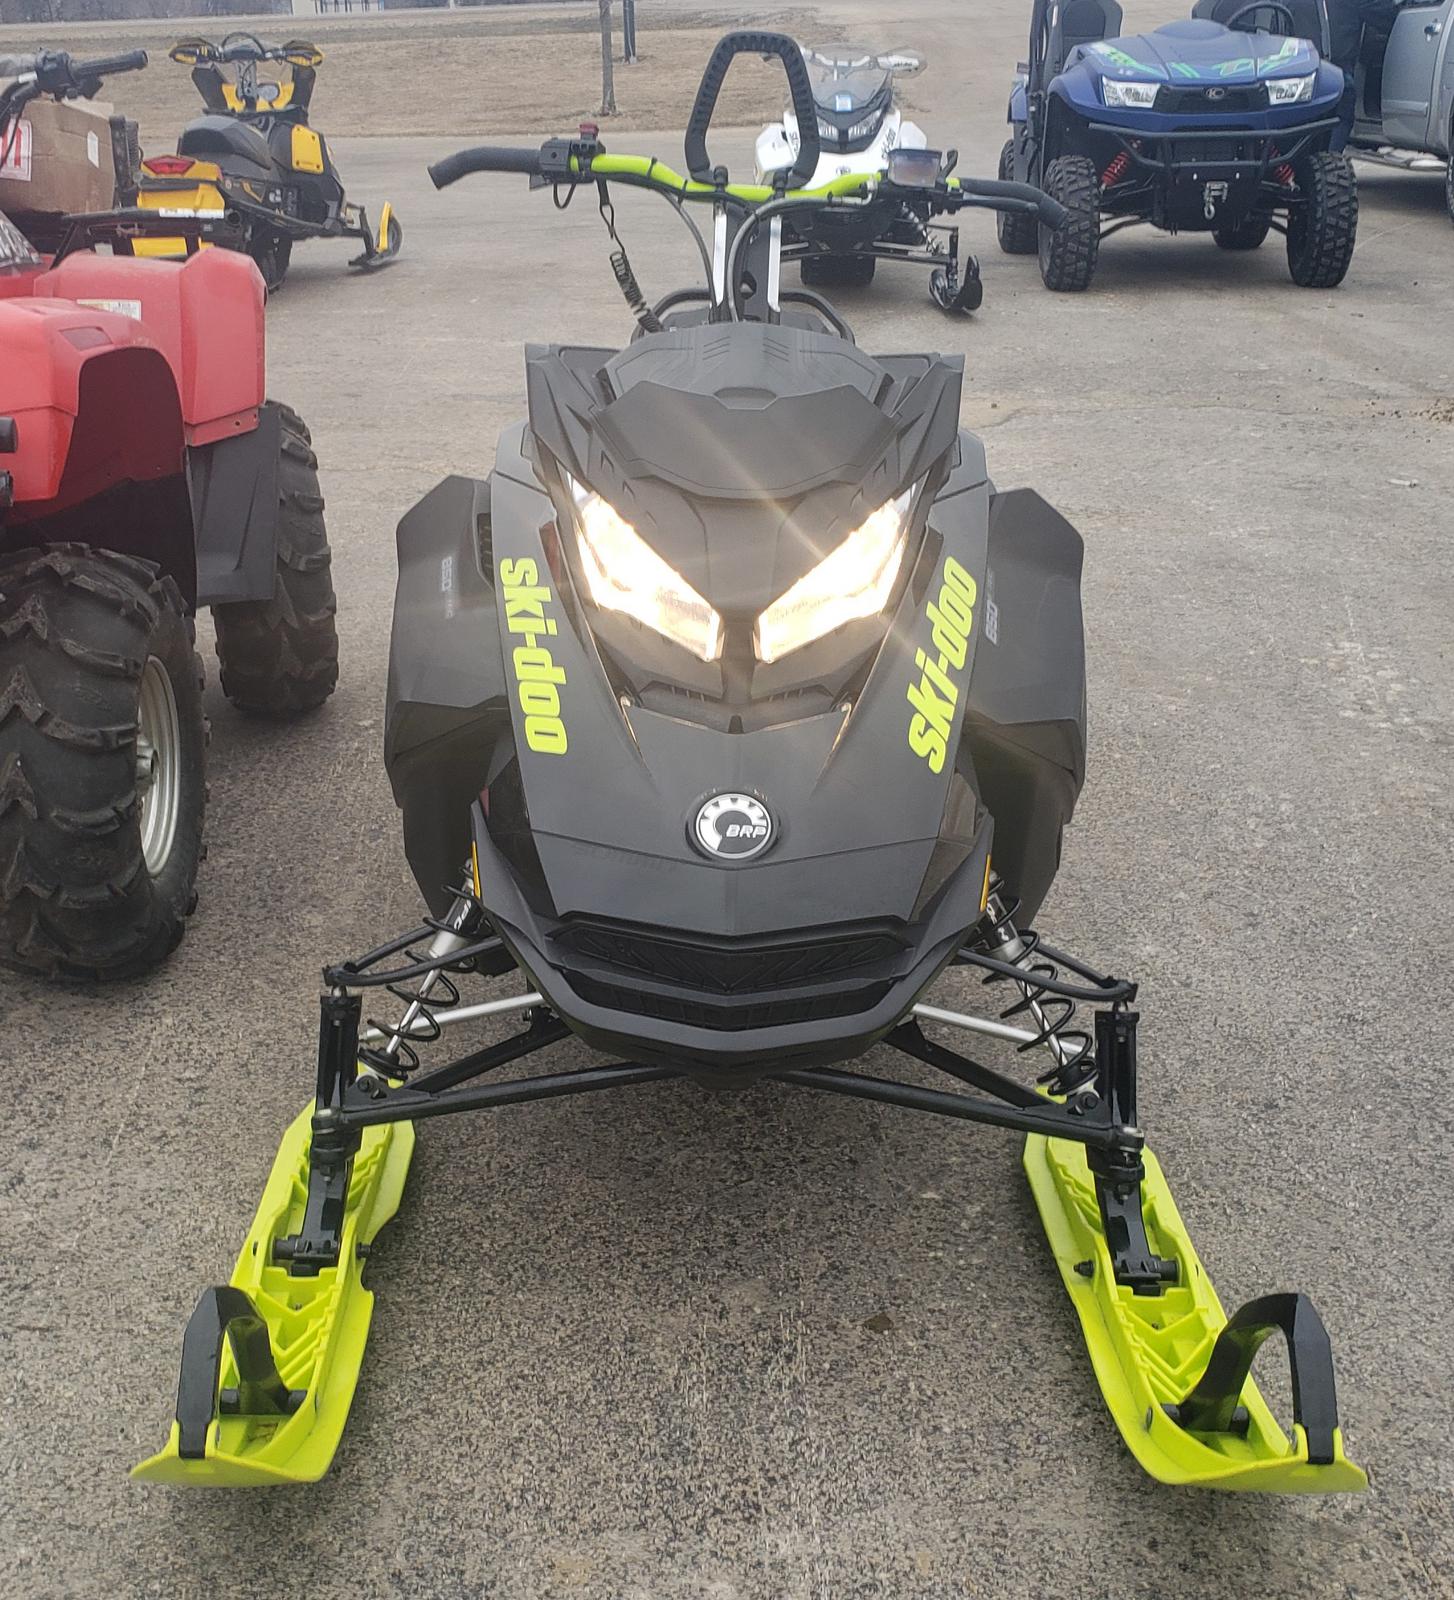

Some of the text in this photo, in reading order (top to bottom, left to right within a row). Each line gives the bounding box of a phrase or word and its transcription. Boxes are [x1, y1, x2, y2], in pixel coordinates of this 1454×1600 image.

[500, 557, 568, 755] ski-doo
[906, 556, 977, 774] ski-doo
[726, 824, 767, 839] BRP
